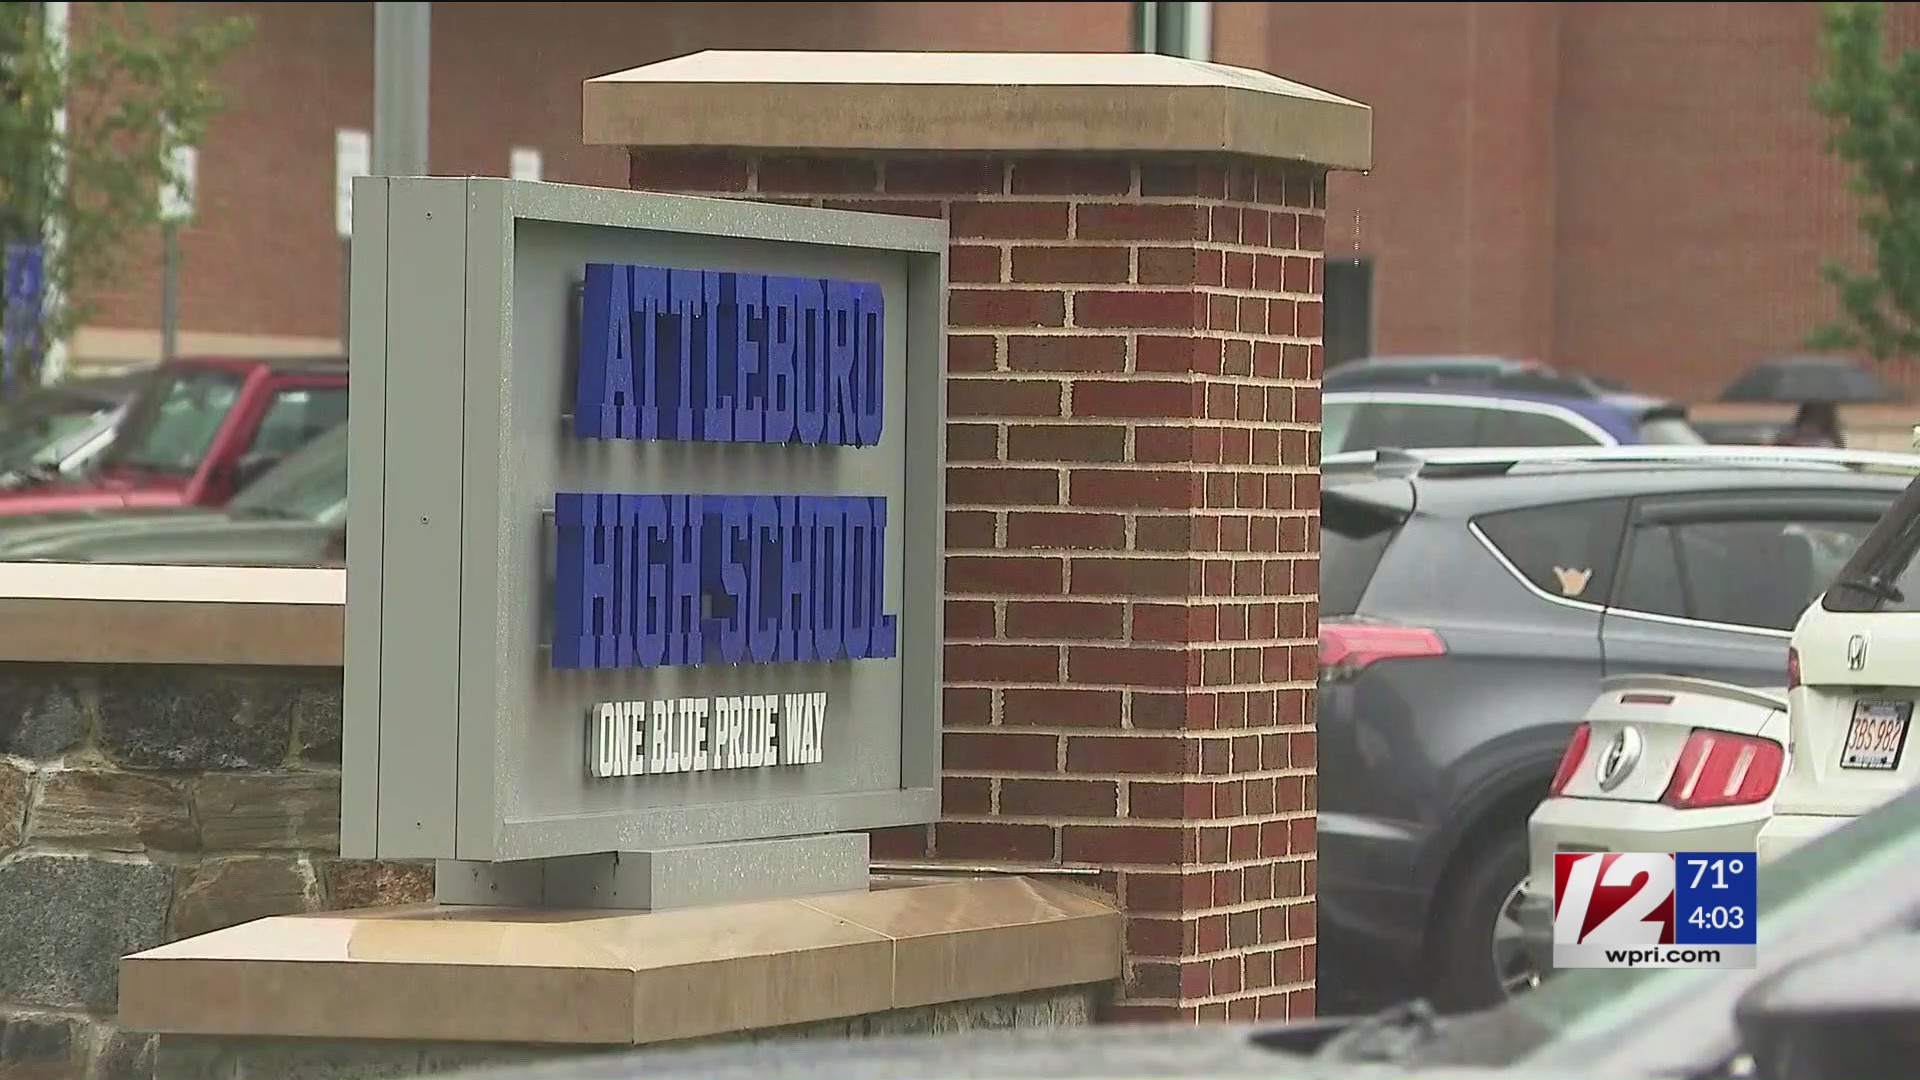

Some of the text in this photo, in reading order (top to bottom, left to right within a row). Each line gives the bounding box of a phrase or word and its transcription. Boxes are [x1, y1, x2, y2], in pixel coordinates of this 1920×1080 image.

[600, 264, 884, 447] ATTLEBORO
[578, 493, 897, 668] HIGH SCHOOL
[600, 692, 827, 778] ONE BLUE PRIDE WAY
